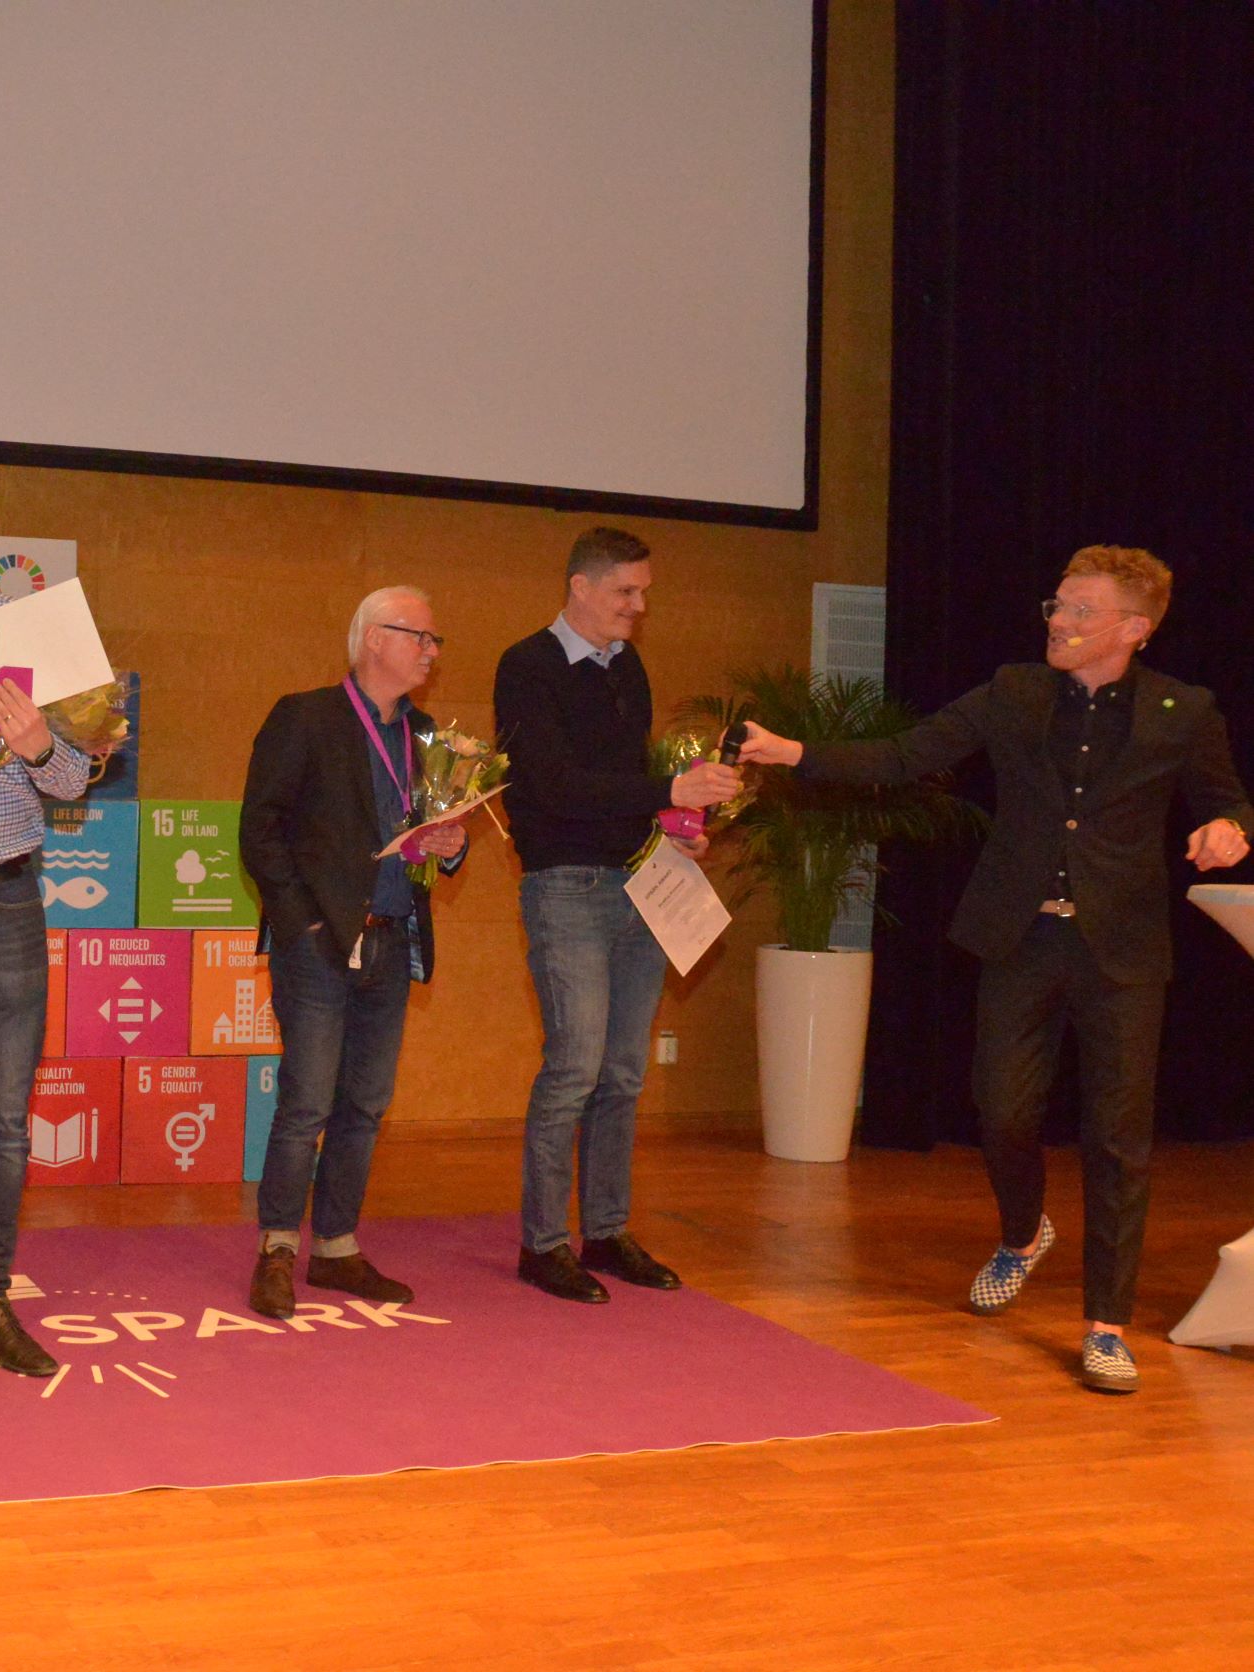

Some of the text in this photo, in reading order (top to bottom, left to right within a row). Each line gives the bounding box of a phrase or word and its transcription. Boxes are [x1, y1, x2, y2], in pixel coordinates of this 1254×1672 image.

[53, 808, 103, 821] LIFE BELOW
[181, 810, 199, 821] LIFE
[53, 823, 83, 836] WATER
[152, 809, 174, 837] 15
[181, 825, 218, 837] ON LAND
[109, 938, 150, 951] REDUCED
[78, 938, 103, 966] 10
[204, 940, 222, 967] 11
[109, 954, 166, 966] INEQUALITIES
[35, 1067, 73, 1080] QUALITY
[162, 1067, 196, 1078] GENDER
[138, 1066, 151, 1093] 5
[260, 1066, 274, 1093] 6
[36, 1083, 85, 1095] EDUCATION
[161, 1081, 203, 1093] EQUALITY
[40, 1300, 452, 1344] SPARK
